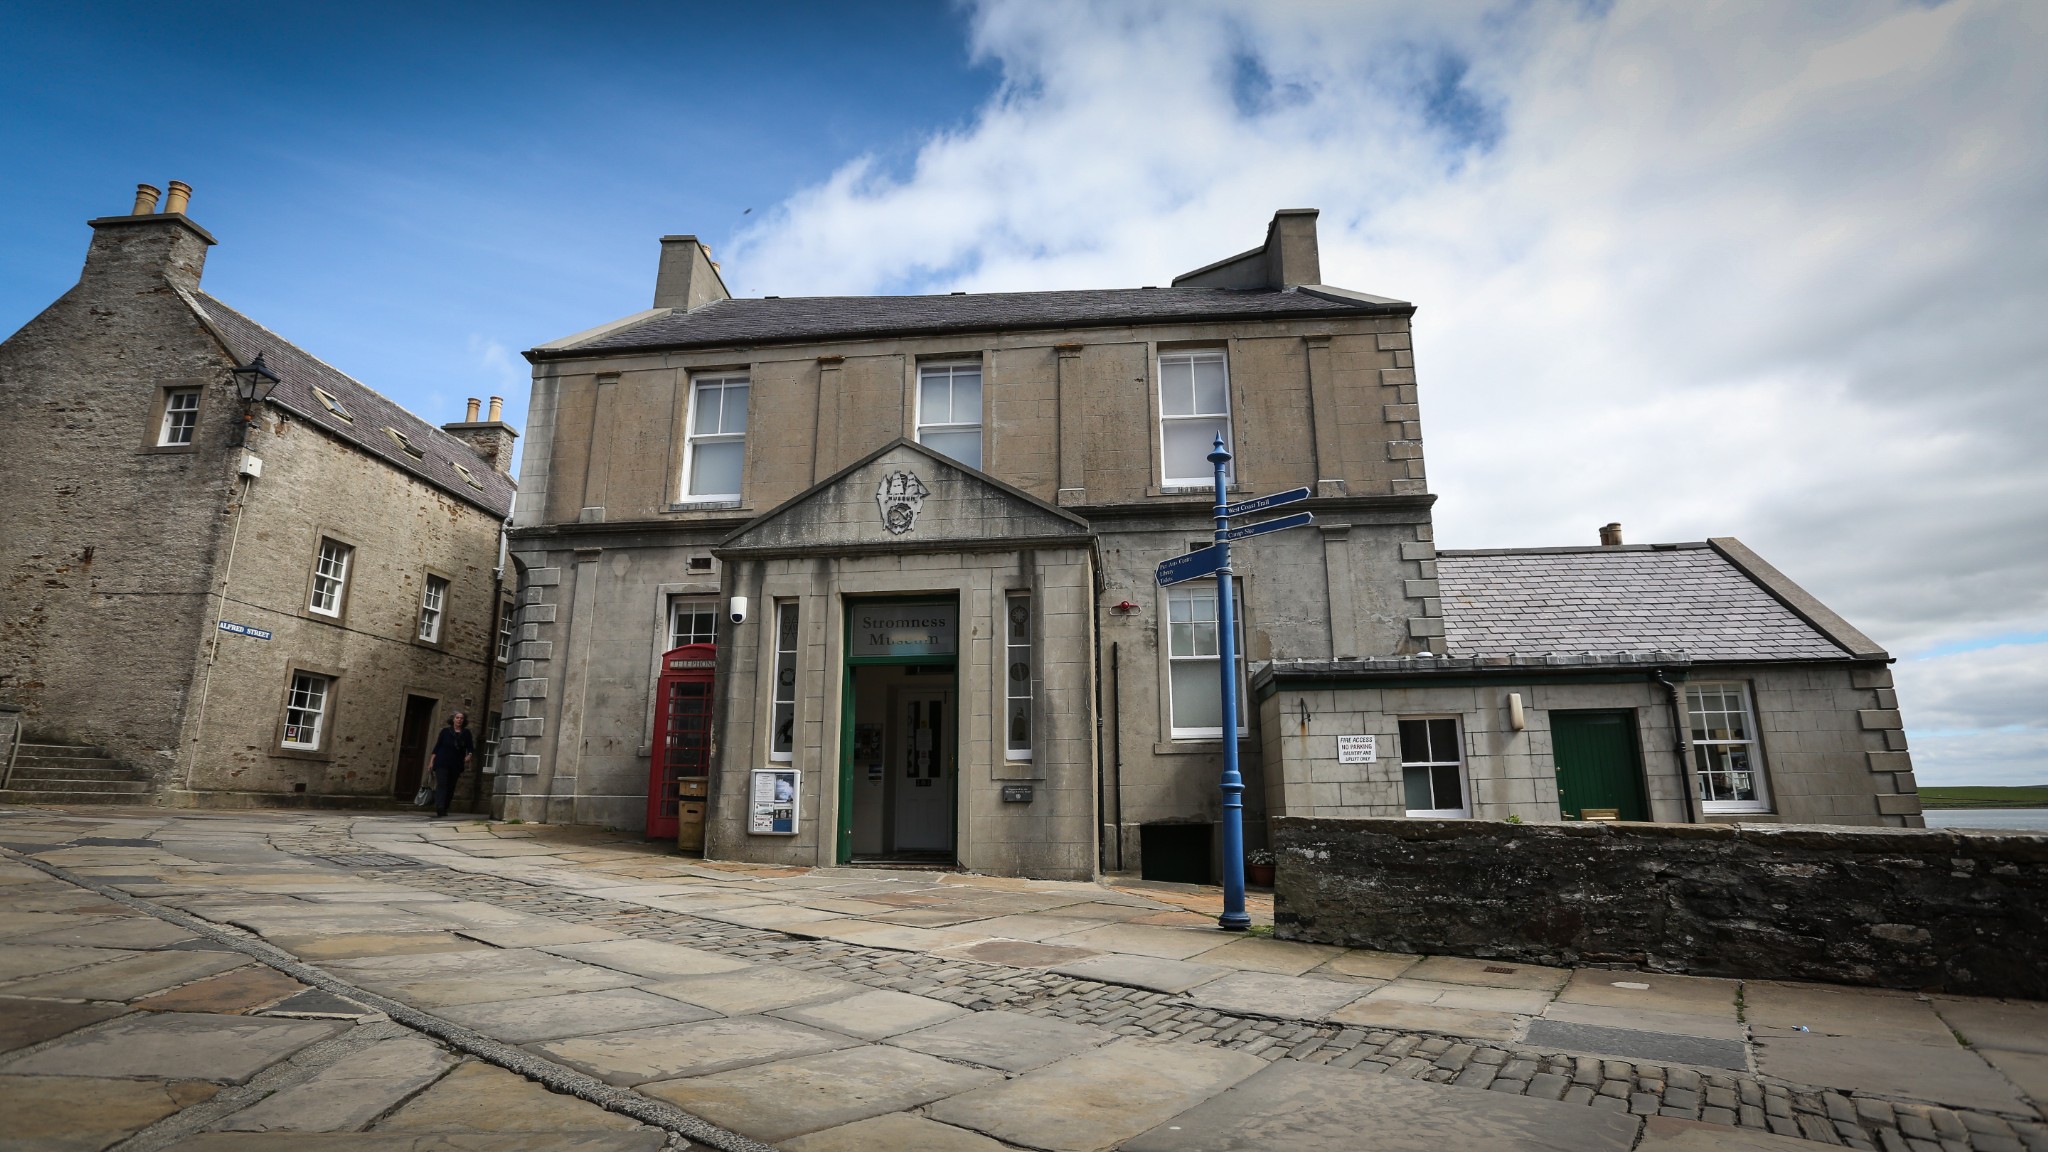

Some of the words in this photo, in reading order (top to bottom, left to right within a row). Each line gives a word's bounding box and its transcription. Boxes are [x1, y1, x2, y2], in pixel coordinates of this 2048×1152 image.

[1241, 503, 1255, 511] Coast
[1257, 499, 1269, 507] Trail
[1228, 531, 1243, 539] Camp
[863, 617, 946, 629] Stromness
[219, 622, 244, 633] ALFRED
[247, 628, 270, 638] STREET
[671, 660, 716, 668] TELEPHONE
